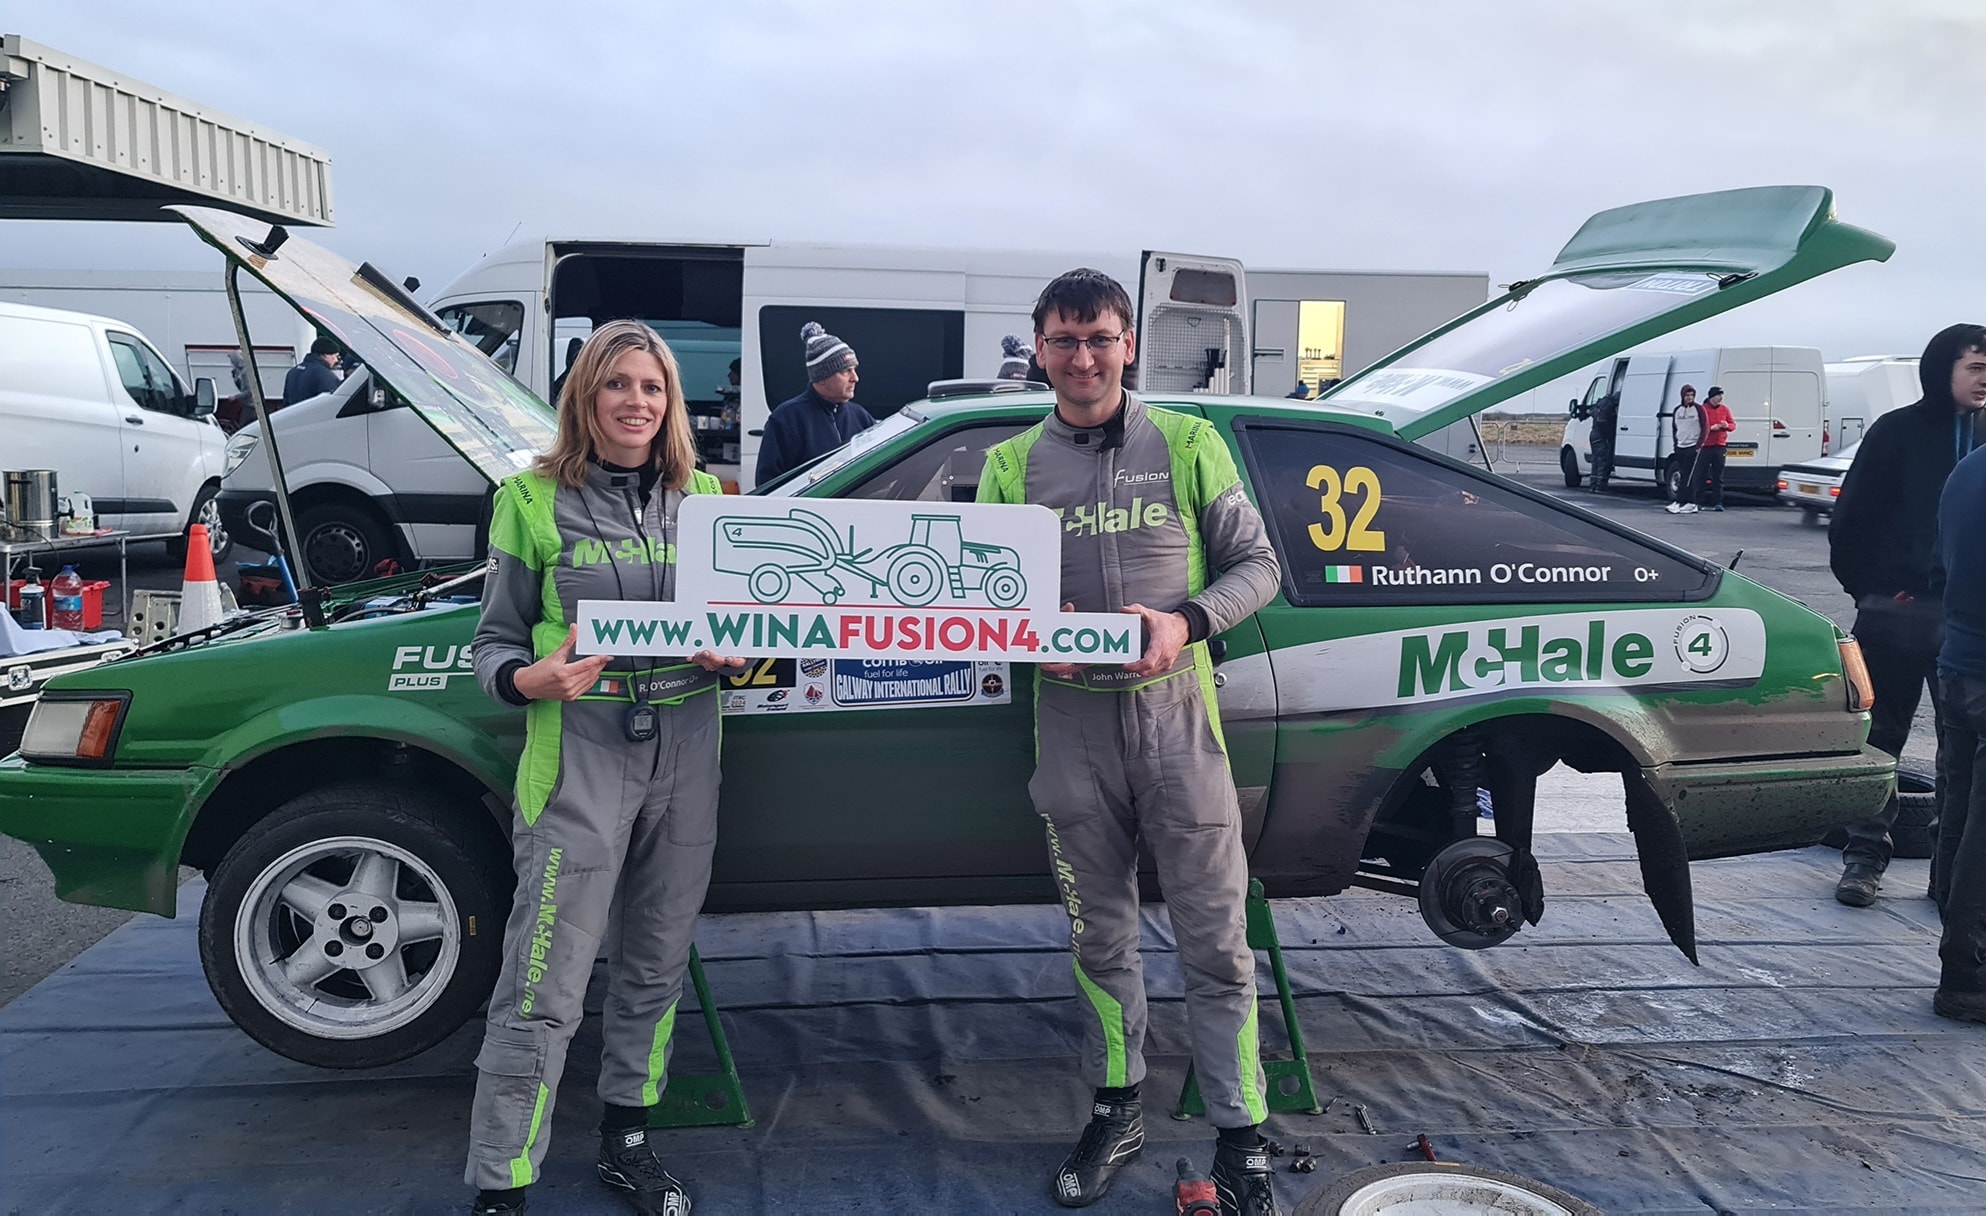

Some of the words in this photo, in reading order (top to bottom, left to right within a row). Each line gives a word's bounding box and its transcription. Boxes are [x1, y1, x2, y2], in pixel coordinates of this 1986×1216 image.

[1053, 497, 1168, 537] cHale
[1304, 463, 1387, 553] 32
[731, 527, 743, 537] 4
[572, 536, 677, 569] McHa
[1371, 565, 1481, 586] Ruthann
[1489, 563, 1611, 584] O'Connor
[1687, 632, 1713, 657] 4
[392, 644, 474, 670] FUS
[1397, 620, 1655, 698] McHale
[394, 677, 441, 687] PLUS
[650, 678, 689, 691] O'Connor
[836, 673, 874, 701] GALWAY
[873, 677, 944, 699] INTERNATIONAL
[943, 668, 971, 695] RALLY
[864, 669, 881, 679] fuel
[882, 668, 895, 678] for
[895, 667, 909, 677] life
[1092, 672, 1113, 681] John
[1093, 1105, 1111, 1115] OMP
[625, 1133, 645, 1145] OMP
[1246, 1158, 1267, 1166] OMP
[1063, 1173, 1078, 1198] OMP
